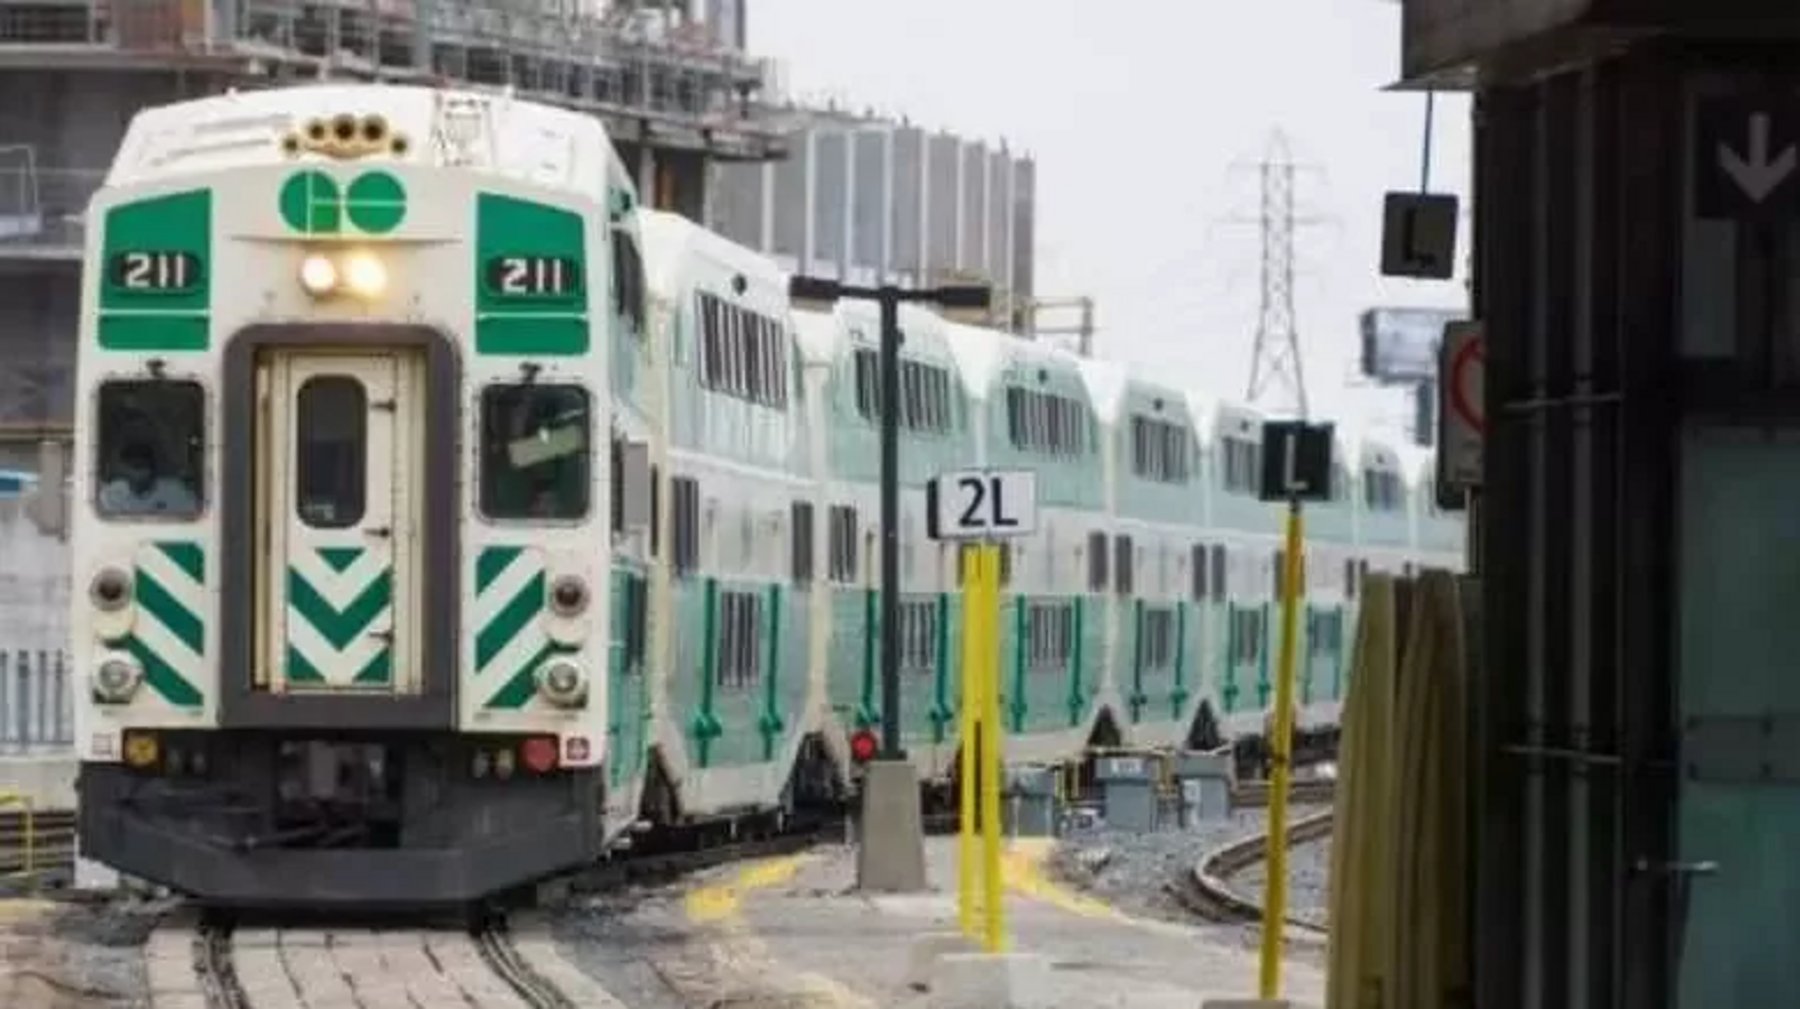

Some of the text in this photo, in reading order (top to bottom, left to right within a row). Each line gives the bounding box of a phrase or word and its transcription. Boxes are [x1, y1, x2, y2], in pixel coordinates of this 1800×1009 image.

[126, 252, 184, 288] 211
[502, 258, 561, 293] 211
[1285, 434, 1309, 490] L
[959, 478, 1018, 527] 2L
